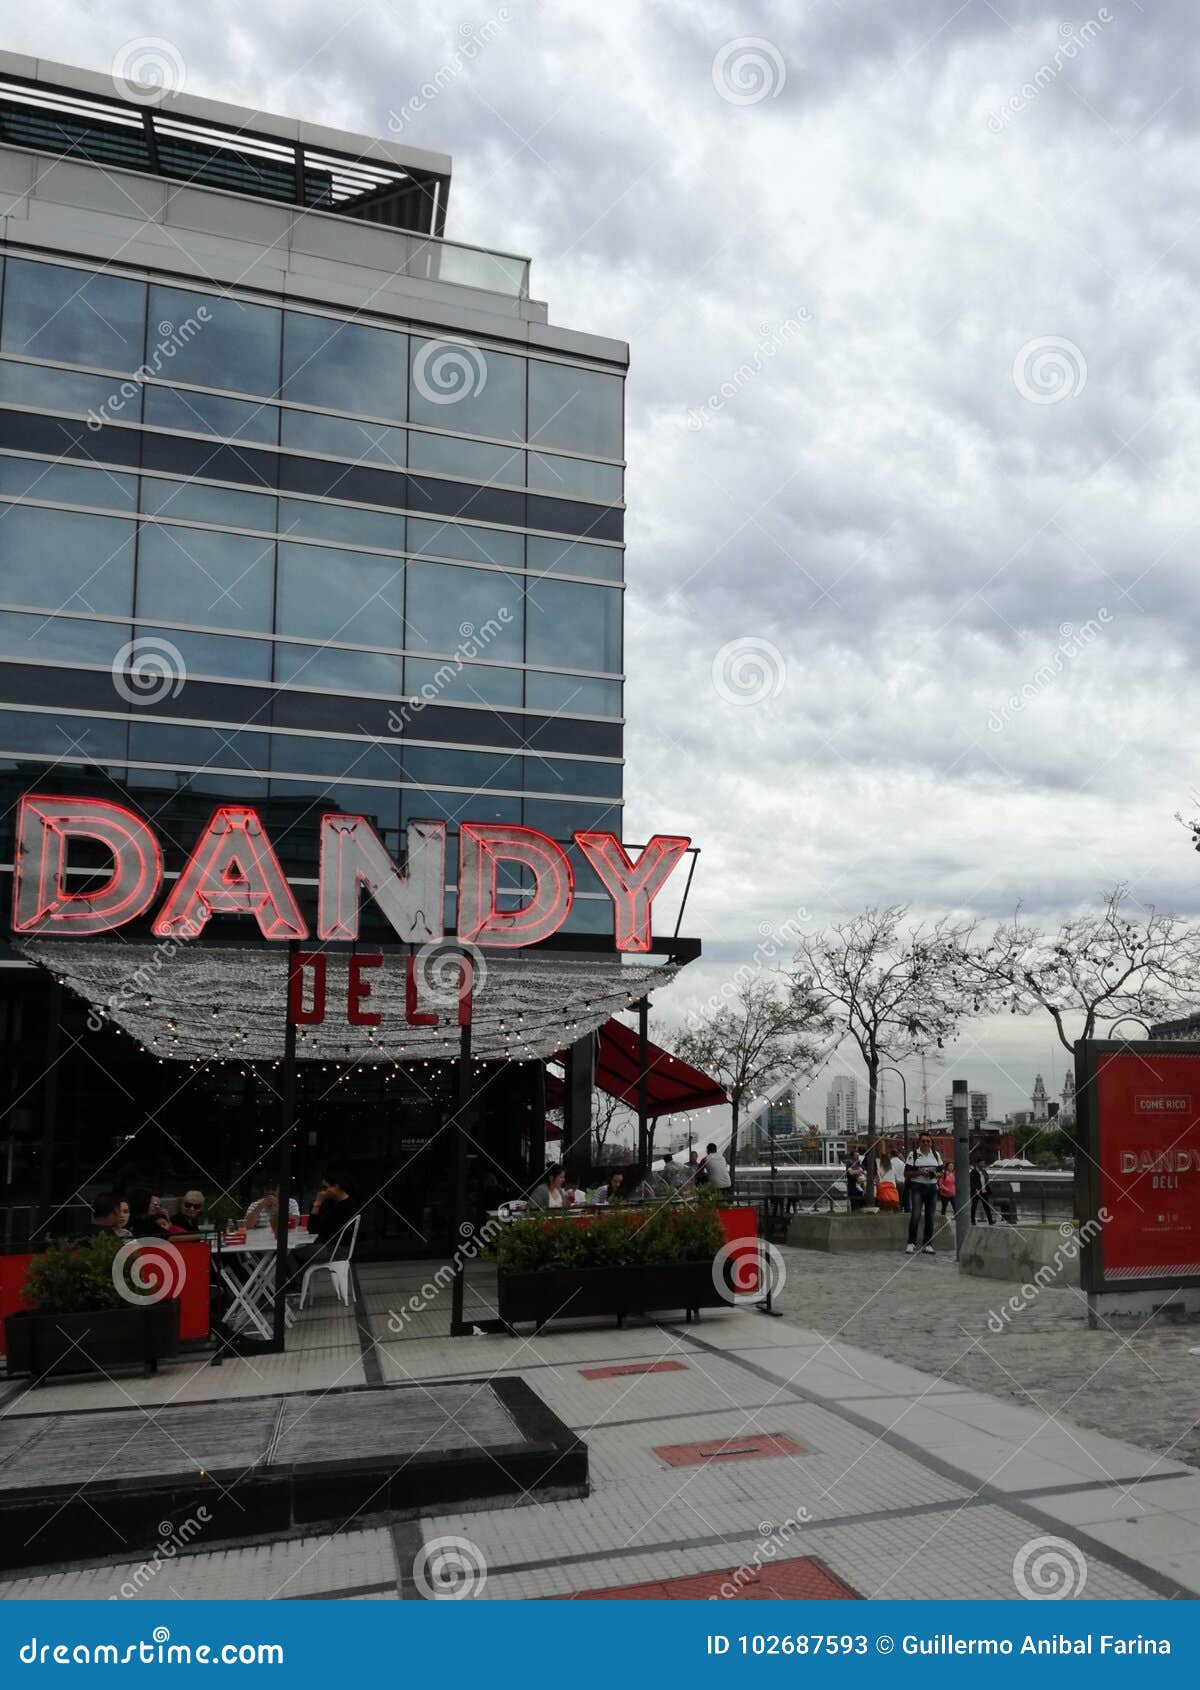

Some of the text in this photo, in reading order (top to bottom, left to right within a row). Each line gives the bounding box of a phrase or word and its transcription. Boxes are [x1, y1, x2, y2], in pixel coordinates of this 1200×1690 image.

[12, 794, 692, 952] DANDY
[288, 952, 474, 1025] DELI
[1166, 1099, 1186, 1109] RICO
[1152, 1175, 1179, 1189] DELI
